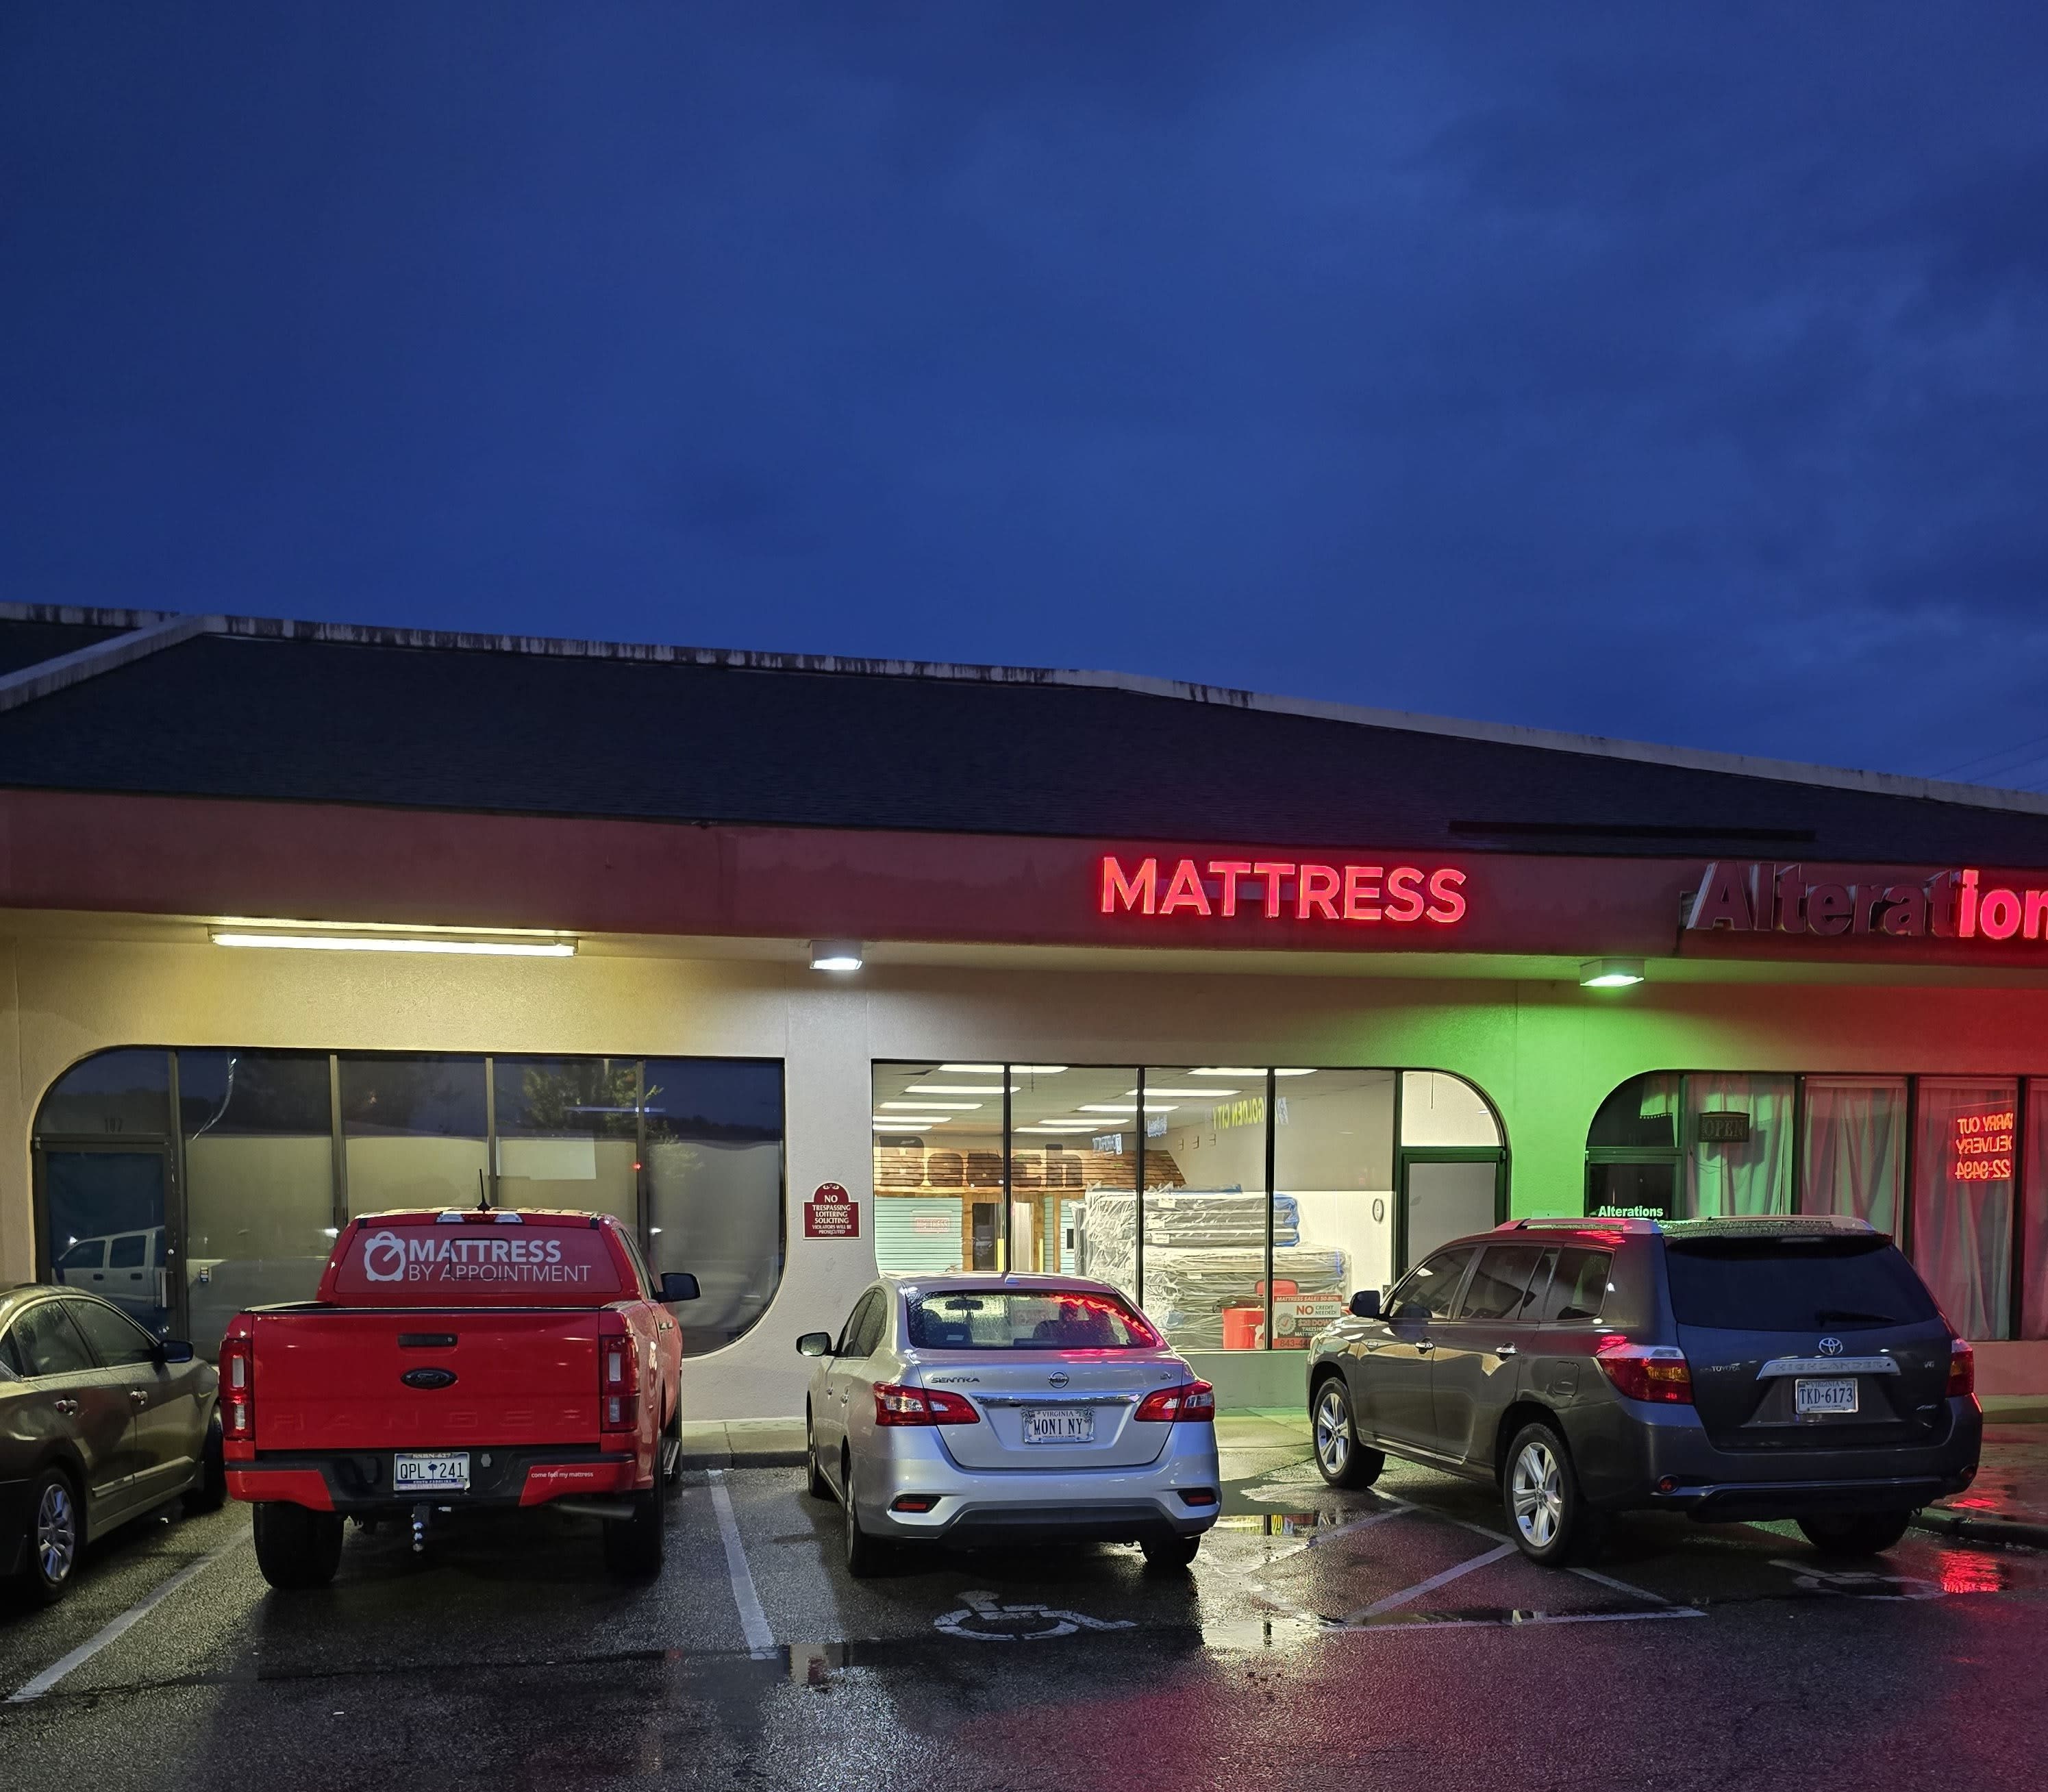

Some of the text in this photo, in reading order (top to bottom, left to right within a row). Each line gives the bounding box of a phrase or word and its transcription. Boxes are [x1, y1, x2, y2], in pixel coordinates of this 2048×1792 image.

[1101, 856, 1467, 923] MATTRESS
[1703, 1119, 1745, 1138] OPEN
[879, 1135, 1083, 1189] Beach
[824, 1195, 838, 1203] NO
[1597, 1205, 1664, 1218] Alterations
[409, 1239, 562, 1263] MATTRESS
[408, 1265, 592, 1282] BY APPOINTMENT
[1296, 1305, 1314, 1315] NO
[1279, 1339, 1311, 1347] 843-44
[1775, 1360, 1884, 1371] HIGHLANDER
[1799, 1387, 1853, 1404] TKD-6173
[1068, 1418, 1083, 1434] NY
[400, 1462, 464, 1479] QPL 241
